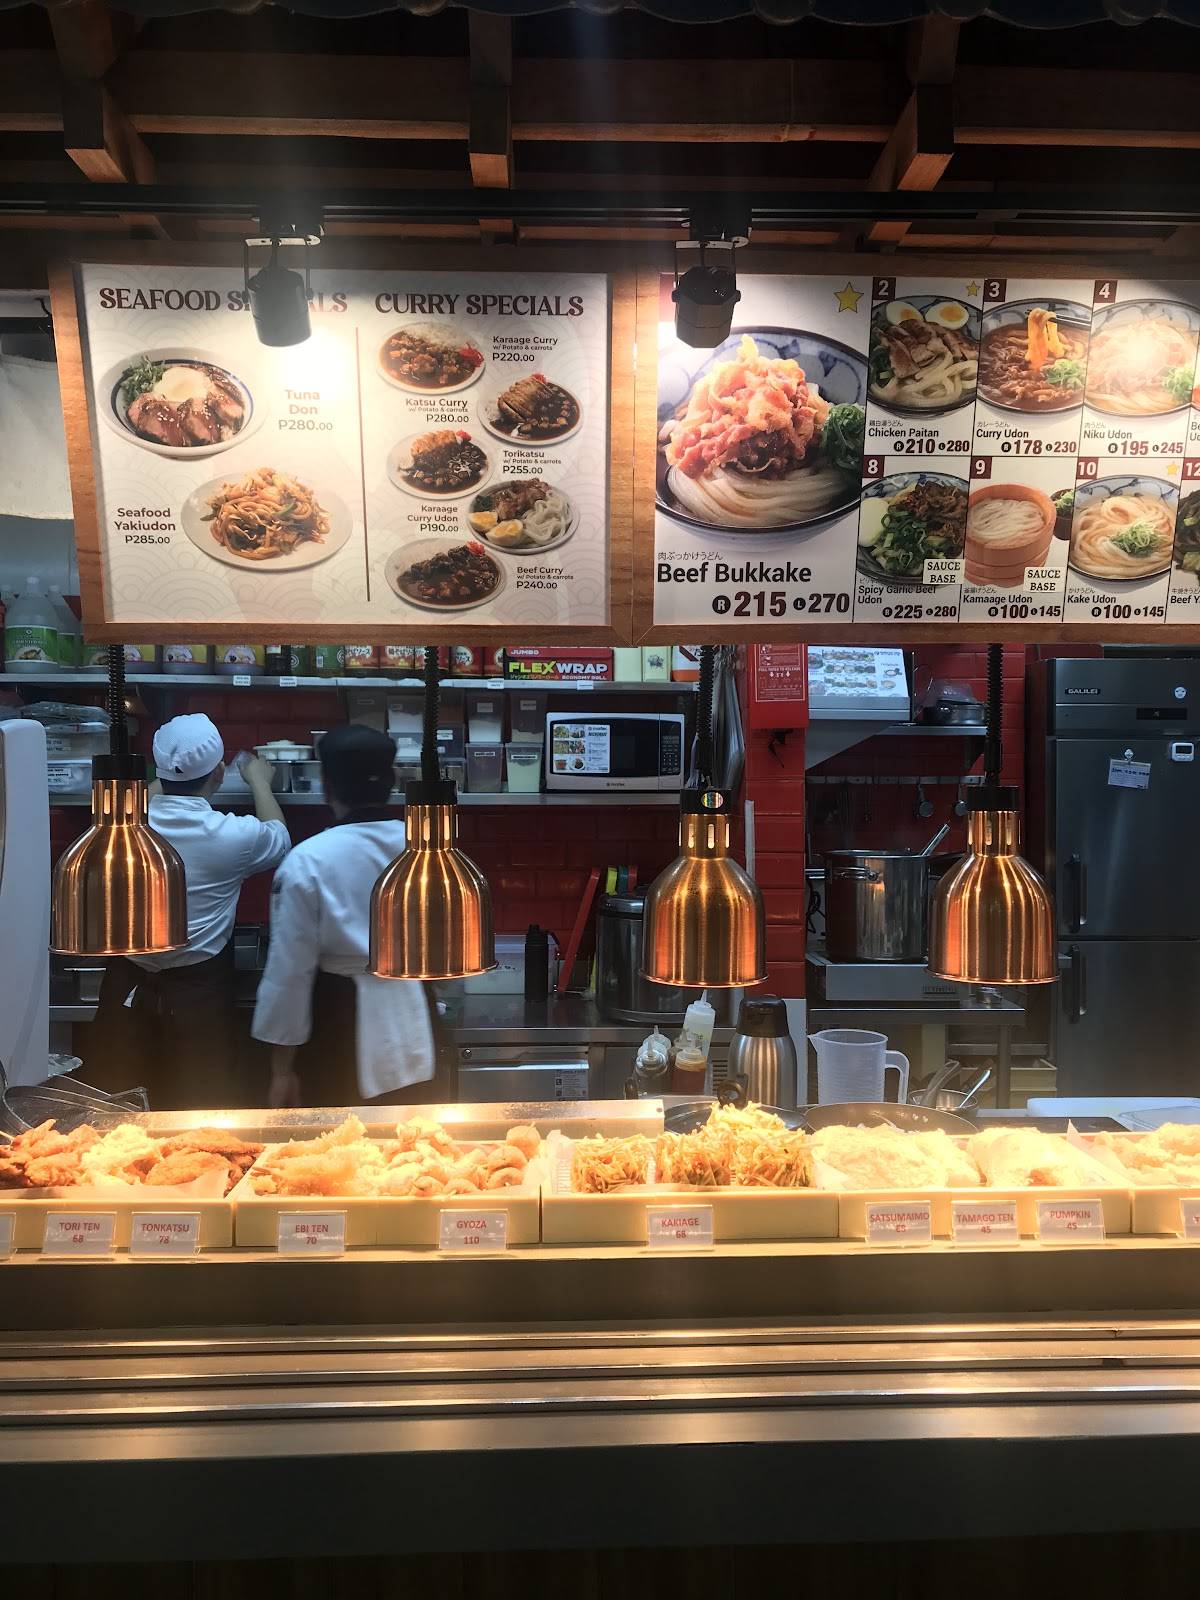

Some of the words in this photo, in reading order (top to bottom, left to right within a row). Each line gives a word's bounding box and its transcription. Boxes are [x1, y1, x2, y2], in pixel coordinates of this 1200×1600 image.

[878, 280, 889, 296] 2
[988, 281, 1000, 297] 3
[1098, 283, 1110, 299] 4
[99, 287, 221, 312] SEAFOOD
[375, 292, 460, 315] CURRY
[465, 294, 585, 317] SPECIALS
[492, 336, 532, 346] Karaage
[533, 336, 559, 346] Curry
[492, 352, 535, 362] P220.00
[284, 389, 321, 401] Tuna
[405, 398, 436, 407] Katsu
[438, 398, 468, 408] Curry
[289, 404, 318, 415] Don
[426, 413, 470, 423] P280.00
[278, 419, 334, 431] P280.00
[868, 427, 906, 437] Chicken
[908, 428, 939, 438] Paitan
[976, 428, 1002, 440] Curry
[1004, 428, 1029, 438] Udon
[1083, 429, 1105, 439] Niku
[1107, 430, 1133, 439] Udon
[905, 438, 936, 454] 210
[946, 440, 970, 452] 280
[1014, 439, 1043, 455] 178
[1053, 441, 1077, 453] 230
[1120, 440, 1149, 455] 195
[1160, 442, 1184, 454] 245
[502, 450, 545, 458] Torikatsu
[502, 465, 543, 475] P255.00
[867, 459, 879, 474] 8
[974, 459, 986, 475] 9
[1078, 462, 1097, 476] 10
[116, 507, 171, 518] Seafood
[421, 505, 458, 515] Karaage
[407, 514, 433, 524] Curry
[434, 514, 459, 522] Udon
[113, 520, 176, 532] Yakiudon
[419, 523, 459, 532] P190.00
[124, 534, 171, 545] P285.00
[657, 551, 724, 561] 肉ぶっかけうどん
[516, 566, 538, 574] Beef
[539, 566, 564, 576] Curry
[927, 561, 961, 571] SAUCE
[657, 562, 709, 583] Beef
[714, 561, 812, 583] Bukkake
[1027, 569, 1061, 579] SAUCE
[929, 574, 956, 583] BASE
[516, 580, 558, 589] P240.00
[1030, 582, 1056, 591] BASE
[858, 585, 884, 596] Spicy
[733, 591, 787, 617] 215
[808, 593, 850, 613] 270
[857, 595, 882, 604] Udon
[963, 595, 1006, 605] Kamaage
[1008, 594, 1033, 603] Udon
[1067, 595, 1090, 604] Kake
[1092, 594, 1117, 604] Udon
[1170, 595, 1192, 604] Beef
[894, 604, 923, 619] 225
[934, 606, 957, 617] 280
[1000, 604, 1029, 619] 100
[1039, 605, 1061, 617] 145
[1103, 604, 1132, 619] 100
[1142, 606, 1164, 617] 145
[870, 1212, 930, 1222] SATSUMAIMO
[956, 1214, 996, 1223] TAMAGO
[998, 1213, 1014, 1222] TEN
[1050, 1210, 1091, 1220] PUMPKIN
[59, 1222, 81, 1231] TORI
[83, 1222, 100, 1231] TEN
[456, 1220, 487, 1229] GYOZA
[661, 1217, 700, 1227] KAKIAGE
[1066, 1222, 1078, 1230] 45
[141, 1223, 190, 1232] TONKATSU
[295, 1224, 310, 1233] EBI
[311, 1224, 329, 1233] TEN
[980, 1225, 992, 1234] 45
[72, 1234, 84, 1243] 68
[158, 1235, 170, 1244] 78
[305, 1236, 317, 1245] 70
[463, 1236, 480, 1245] 110
